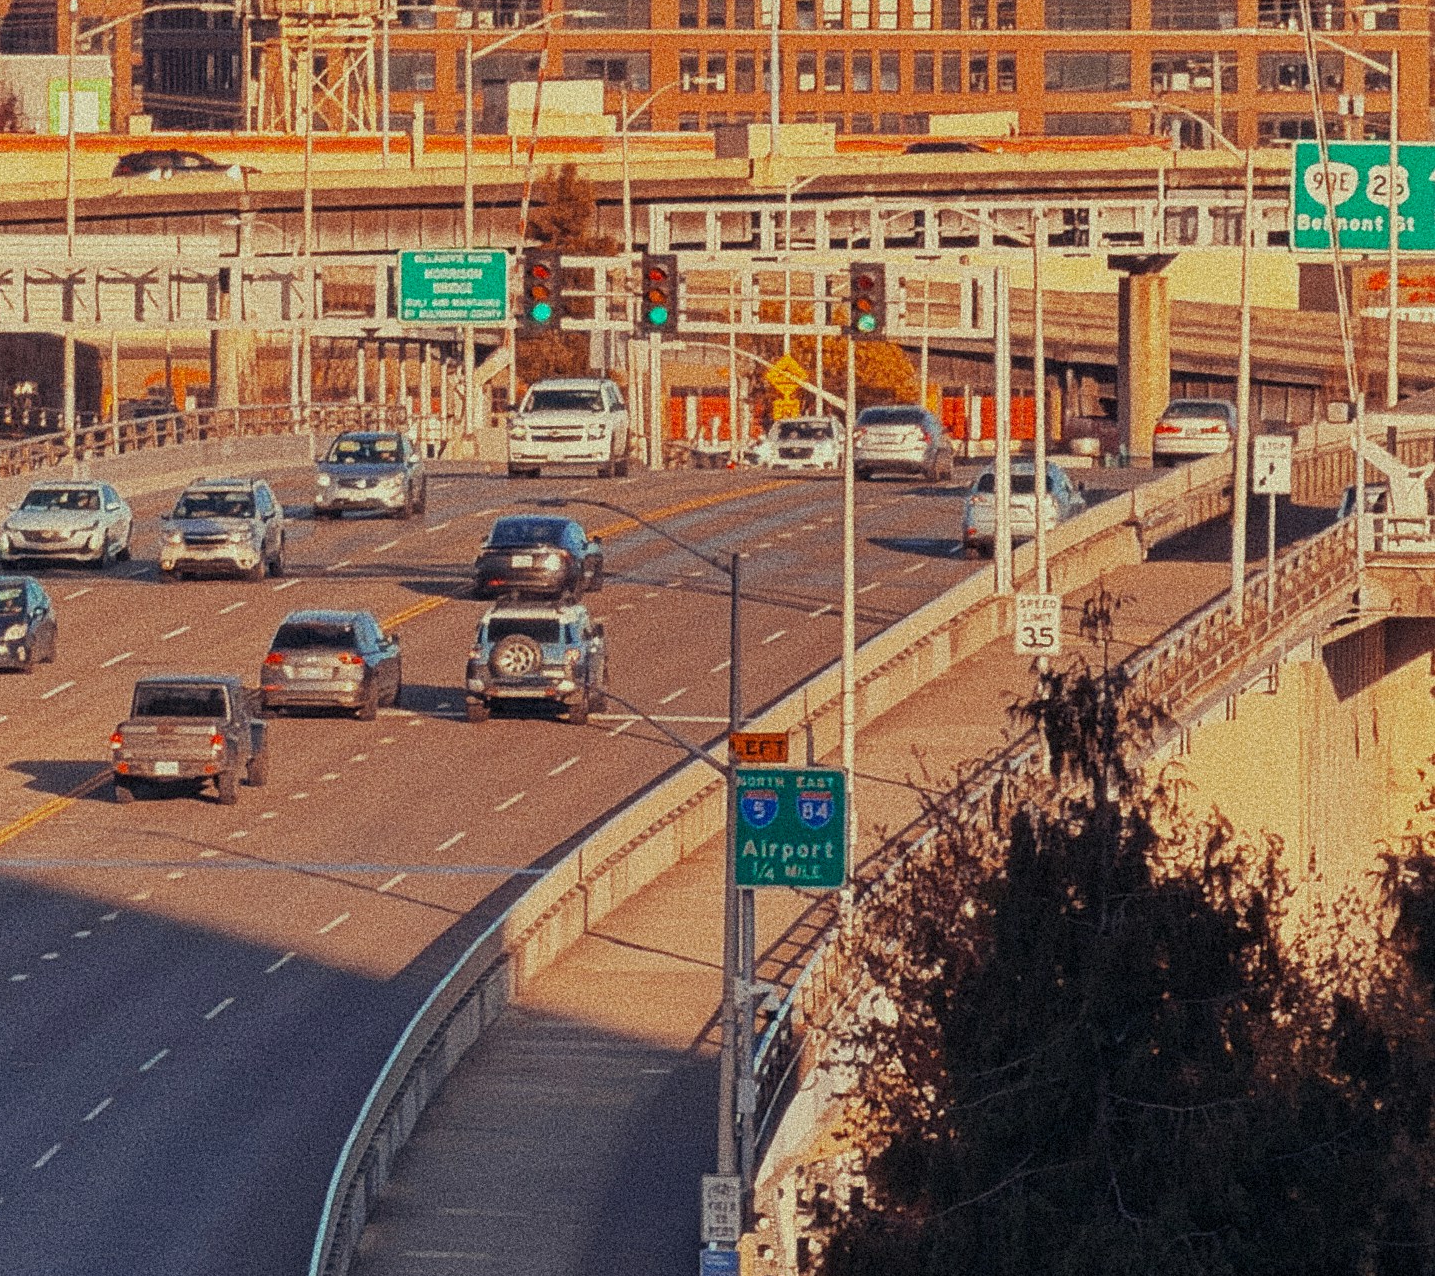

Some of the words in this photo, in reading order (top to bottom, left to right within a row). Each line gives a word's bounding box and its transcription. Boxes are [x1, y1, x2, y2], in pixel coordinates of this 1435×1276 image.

[1019, 598, 1057, 609] SPEED
[1022, 612, 1052, 623] LIMIT
[1022, 626, 1055, 648] 35
[729, 740, 784, 756] LEFT
[736, 775, 785, 788] NORTH
[795, 776, 834, 789] EAST
[752, 800, 766, 819] 5
[801, 801, 829, 820] 84
[741, 838, 834, 863] Airport
[784, 864, 823, 880] MILE
